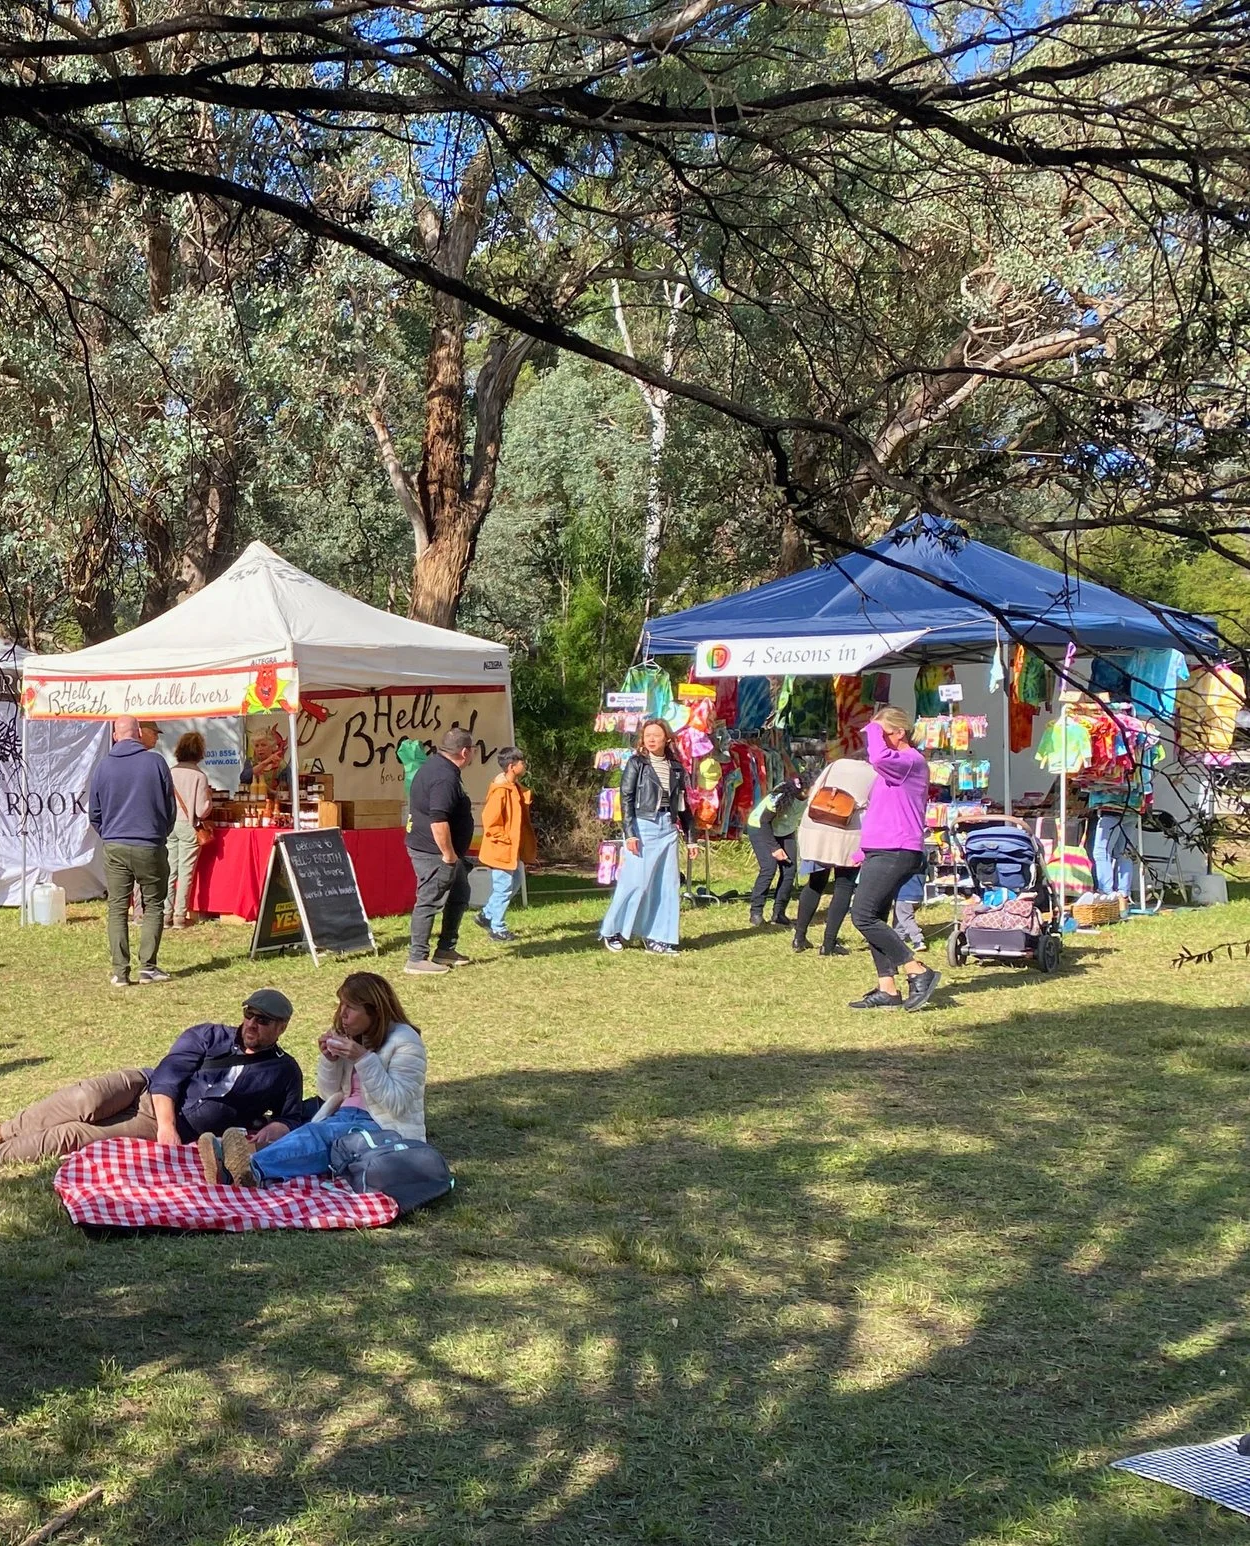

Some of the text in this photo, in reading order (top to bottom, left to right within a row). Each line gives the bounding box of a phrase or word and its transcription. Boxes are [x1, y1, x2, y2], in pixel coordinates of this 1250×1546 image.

[742, 650, 755, 667] 4
[763, 646, 831, 664] Seasons
[838, 643, 858, 661] in
[61, 680, 92, 701] Hells
[123, 682, 232, 713] for chilli lovers
[48, 691, 112, 716] Breath
[373, 688, 441, 738] Hells
[275, 909, 300, 929] YES
